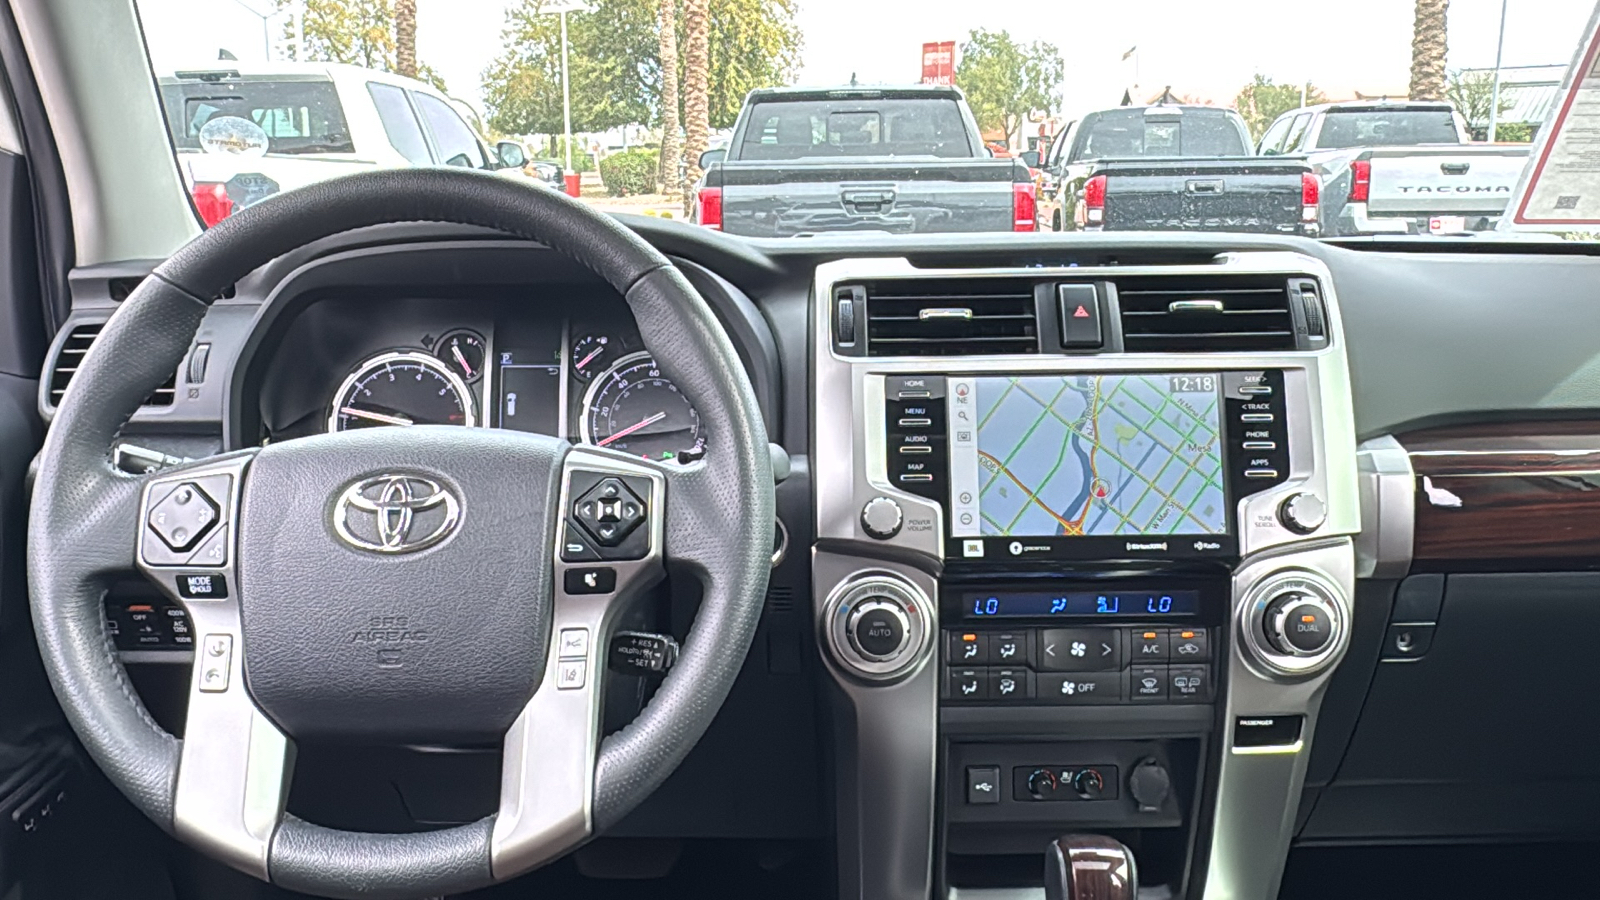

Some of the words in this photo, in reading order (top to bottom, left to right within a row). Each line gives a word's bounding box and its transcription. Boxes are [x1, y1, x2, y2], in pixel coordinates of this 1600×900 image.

[922, 75, 951, 85] THANK
[1397, 185, 1510, 193] TACOMA
[648, 369, 660, 377] 60
[1244, 375, 1261, 383] SEEK
[618, 379, 629, 389] 40
[1172, 377, 1213, 391] 12:18
[956, 396, 968, 404] NE
[600, 406, 610, 417] 20
[1187, 443, 1212, 452] Mesa
[187, 576, 212, 585] MODE
[974, 597, 998, 615] LO
[1147, 596, 1172, 613] LO
[868, 628, 892, 637] AUTO
[1297, 624, 1320, 632] DUAL
[351, 630, 429, 642] AIRBAG
[638, 640, 652, 648] RES
[1142, 644, 1160, 653] A/C
[635, 658, 649, 667] SET
[1077, 683, 1096, 692] OFF
